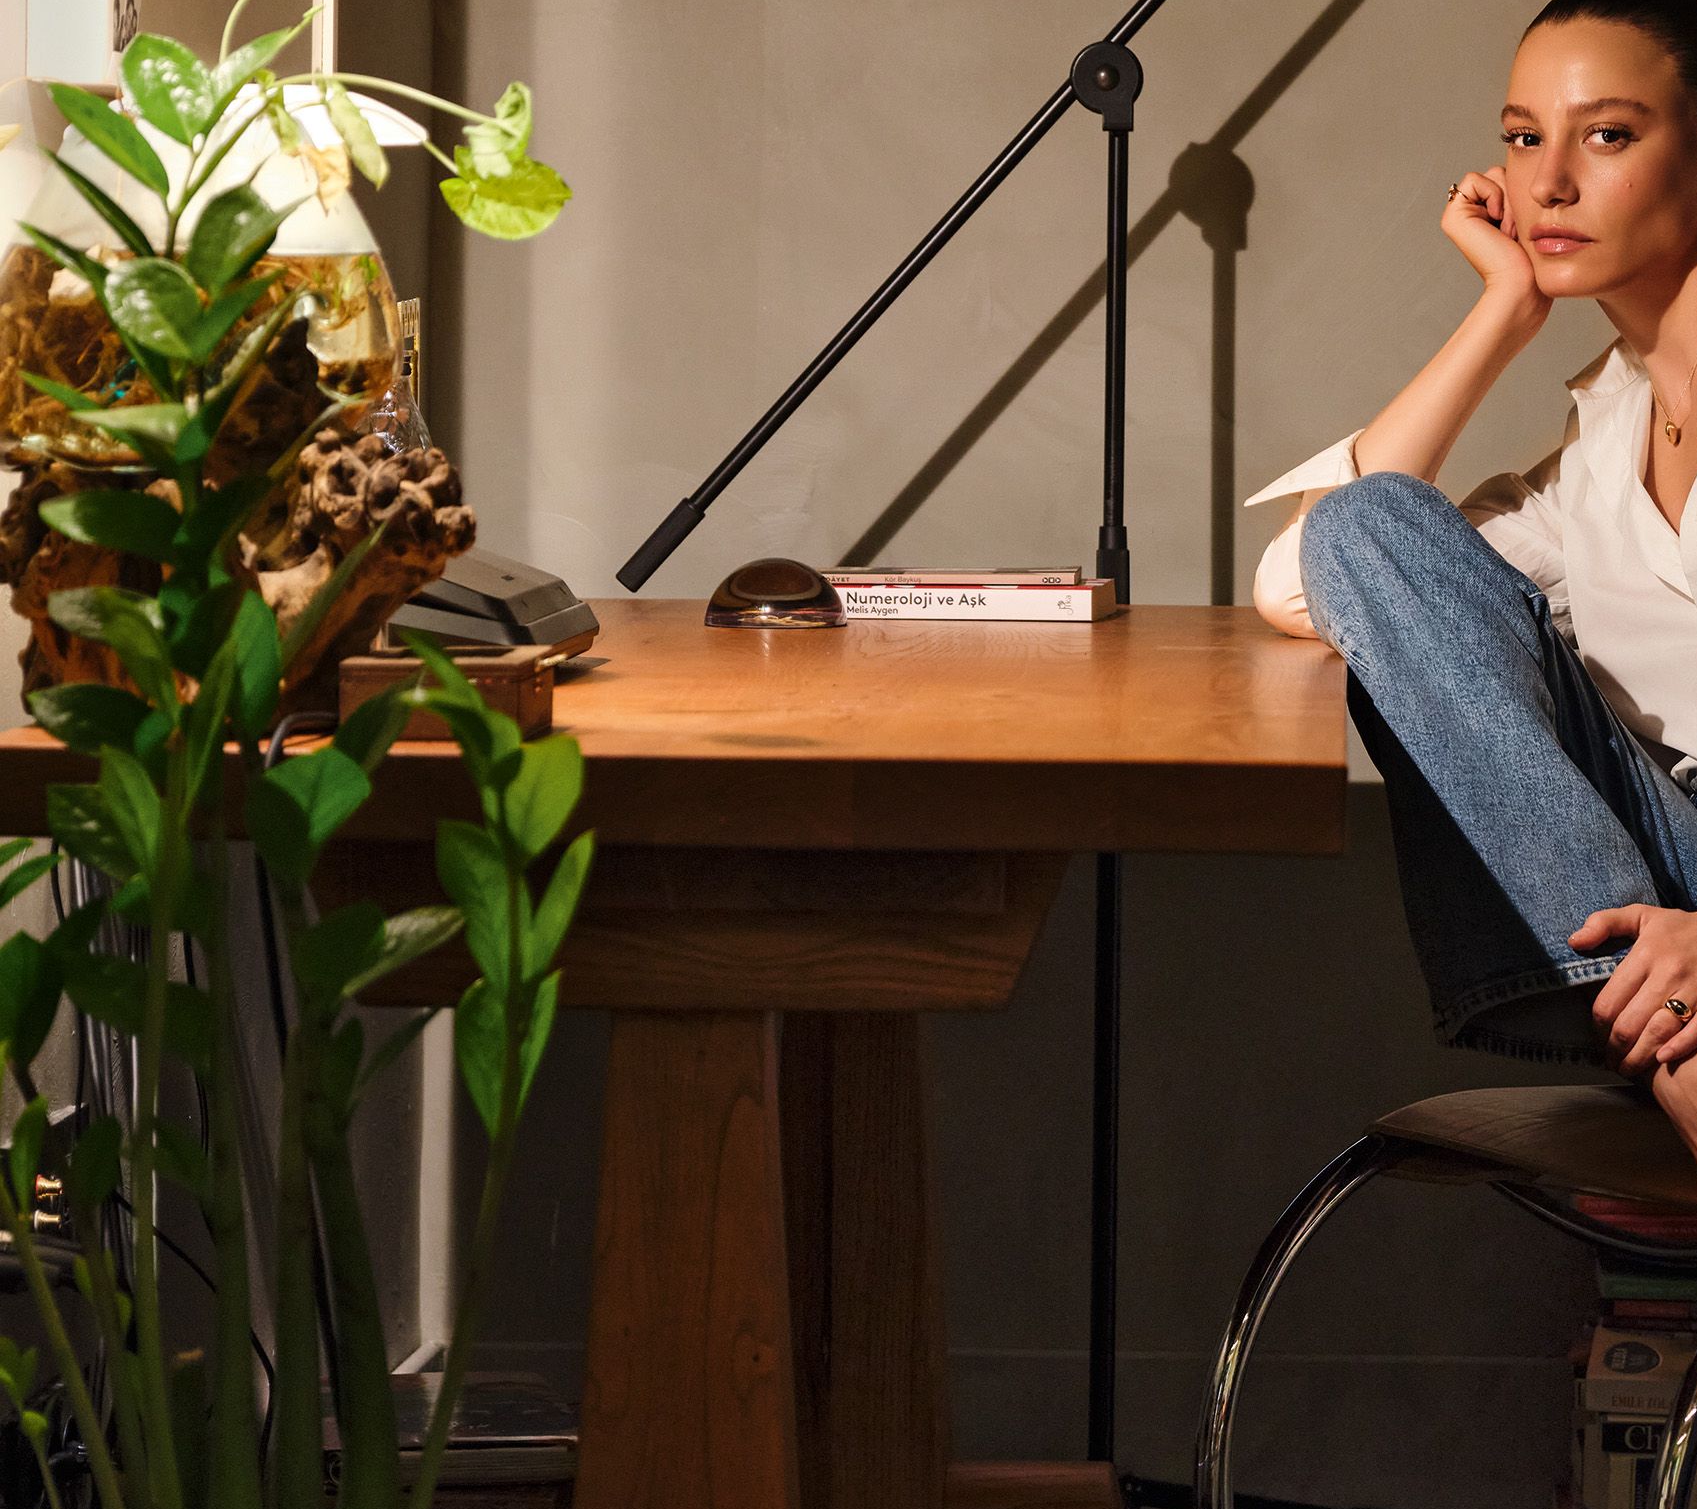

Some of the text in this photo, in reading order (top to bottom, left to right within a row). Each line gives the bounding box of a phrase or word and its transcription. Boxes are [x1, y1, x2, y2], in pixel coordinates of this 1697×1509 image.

[846, 591, 986, 609] Numeroloji ve Aşk
[847, 605, 899, 616] Melis Aygen
